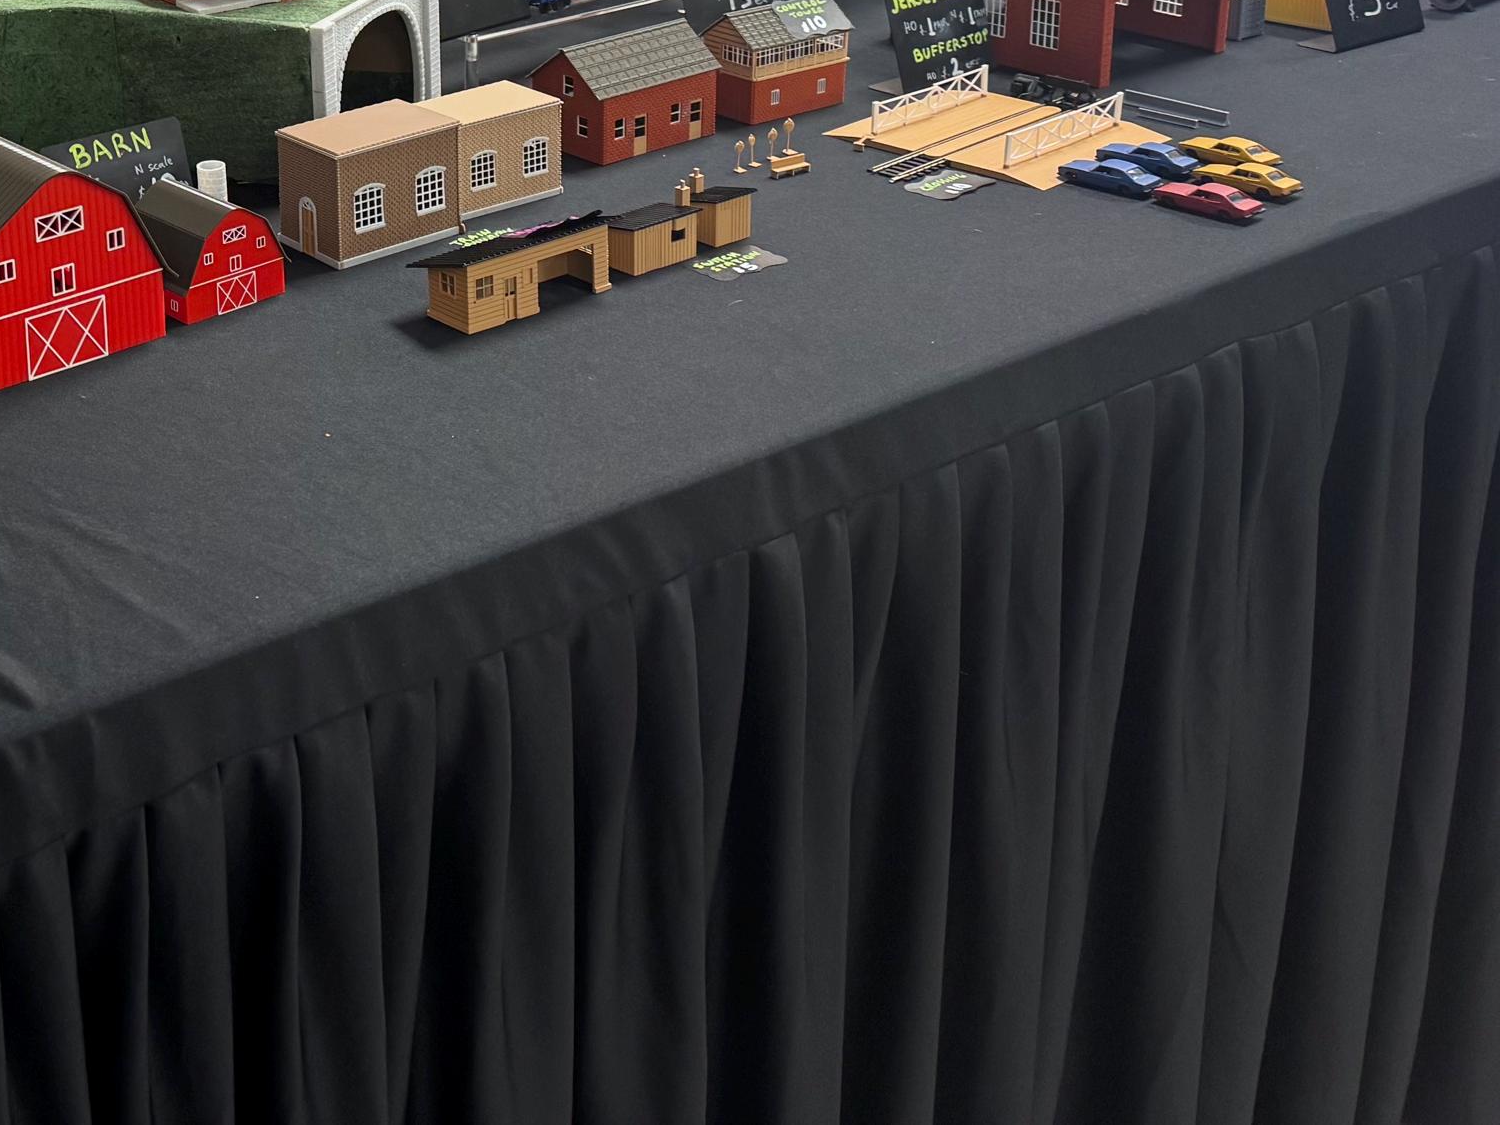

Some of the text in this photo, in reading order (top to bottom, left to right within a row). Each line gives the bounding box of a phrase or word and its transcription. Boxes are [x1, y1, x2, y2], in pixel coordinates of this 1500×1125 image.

[788, 6, 825, 19] TOWER
[903, 20, 918, 35] HO
[912, 27, 989, 64] BUFFERSTOP
[950, 57, 964, 77] 2
[68, 126, 152, 170] BARN
[134, 155, 174, 176] N scale
[710, 250, 761, 272] STATION
